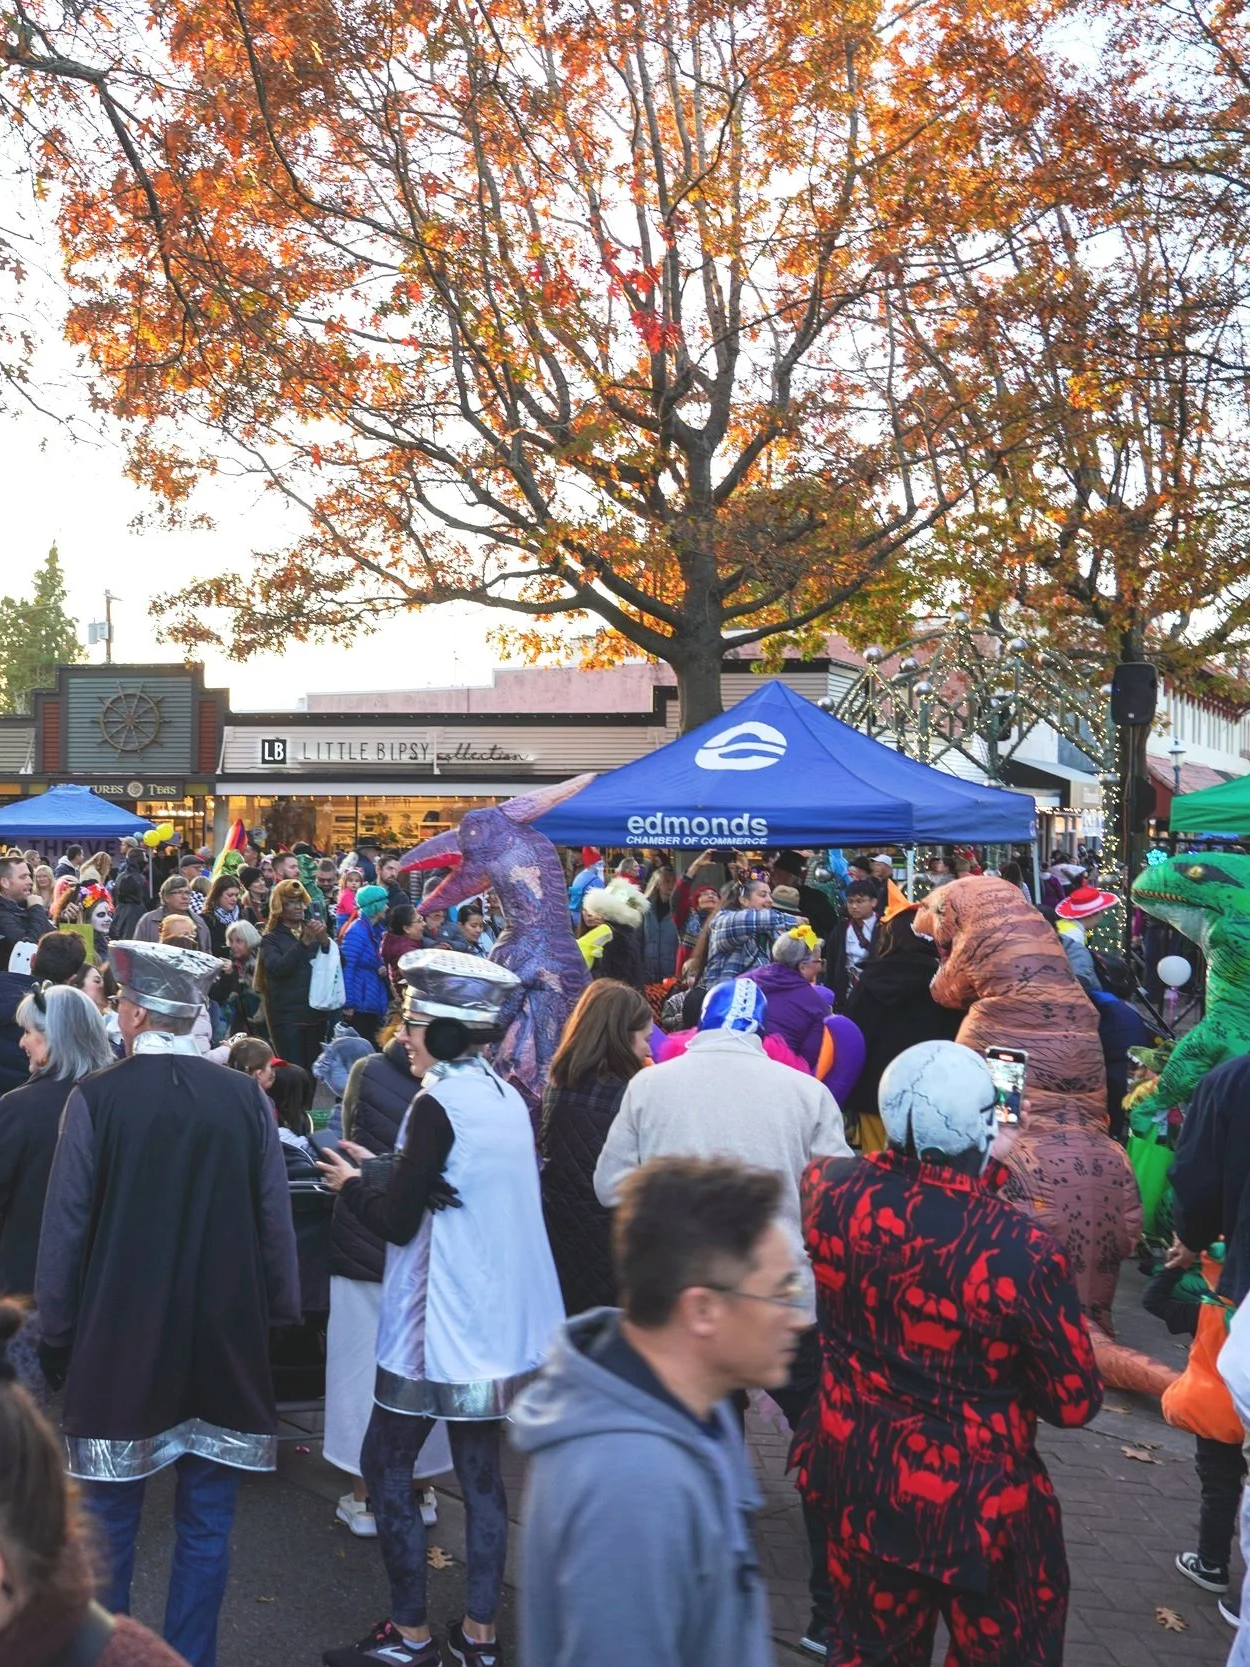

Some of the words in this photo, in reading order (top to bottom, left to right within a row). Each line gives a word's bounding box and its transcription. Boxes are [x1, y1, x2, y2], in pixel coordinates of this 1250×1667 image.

[264, 742, 285, 760] LB
[303, 742, 369, 760] LITTLE
[377, 742, 430, 760] BIPSY
[436, 742, 529, 762] collection
[627, 812, 768, 836] edmonds
[28, 840, 116, 857] THVE
[626, 836, 680, 845] CHAMBER
[683, 836, 699, 845] OF
[701, 837, 768, 846] COMMERCE
